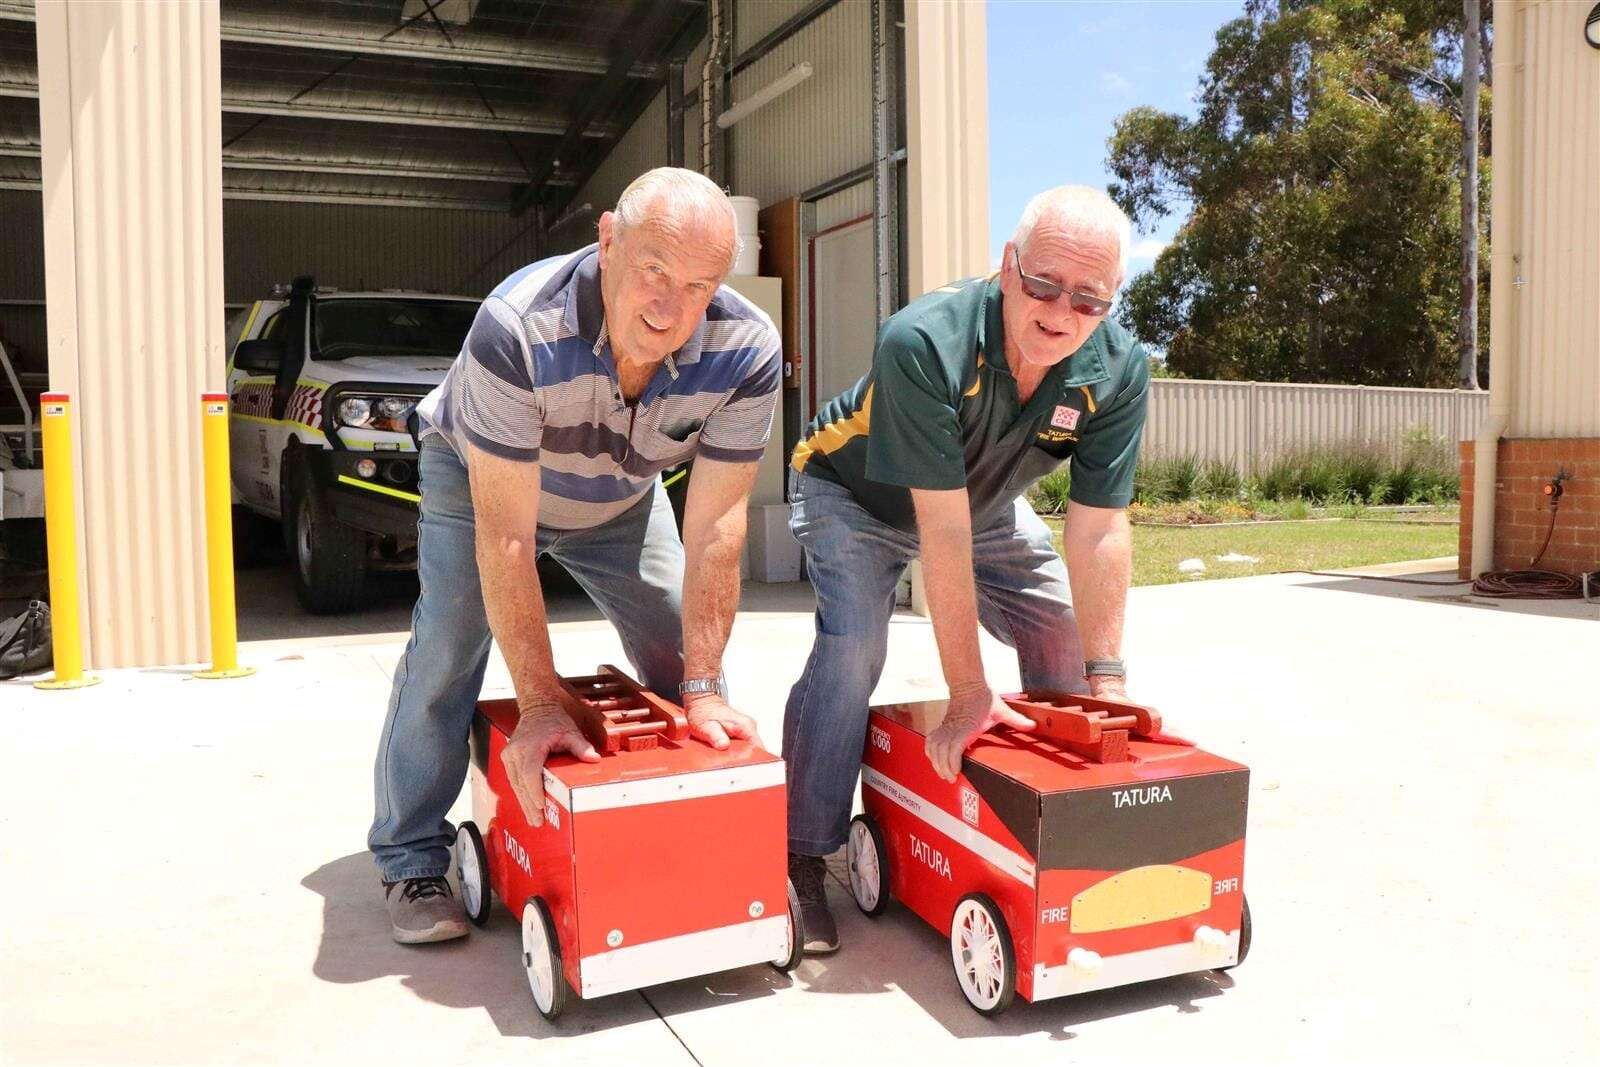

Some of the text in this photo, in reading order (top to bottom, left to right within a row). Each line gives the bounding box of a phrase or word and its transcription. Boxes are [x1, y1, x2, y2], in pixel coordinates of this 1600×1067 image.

[1112, 784, 1173, 808] TATURA
[503, 829, 533, 879] TATURA
[909, 833, 953, 881] TATURA
[1041, 906, 1068, 924] FIRE
